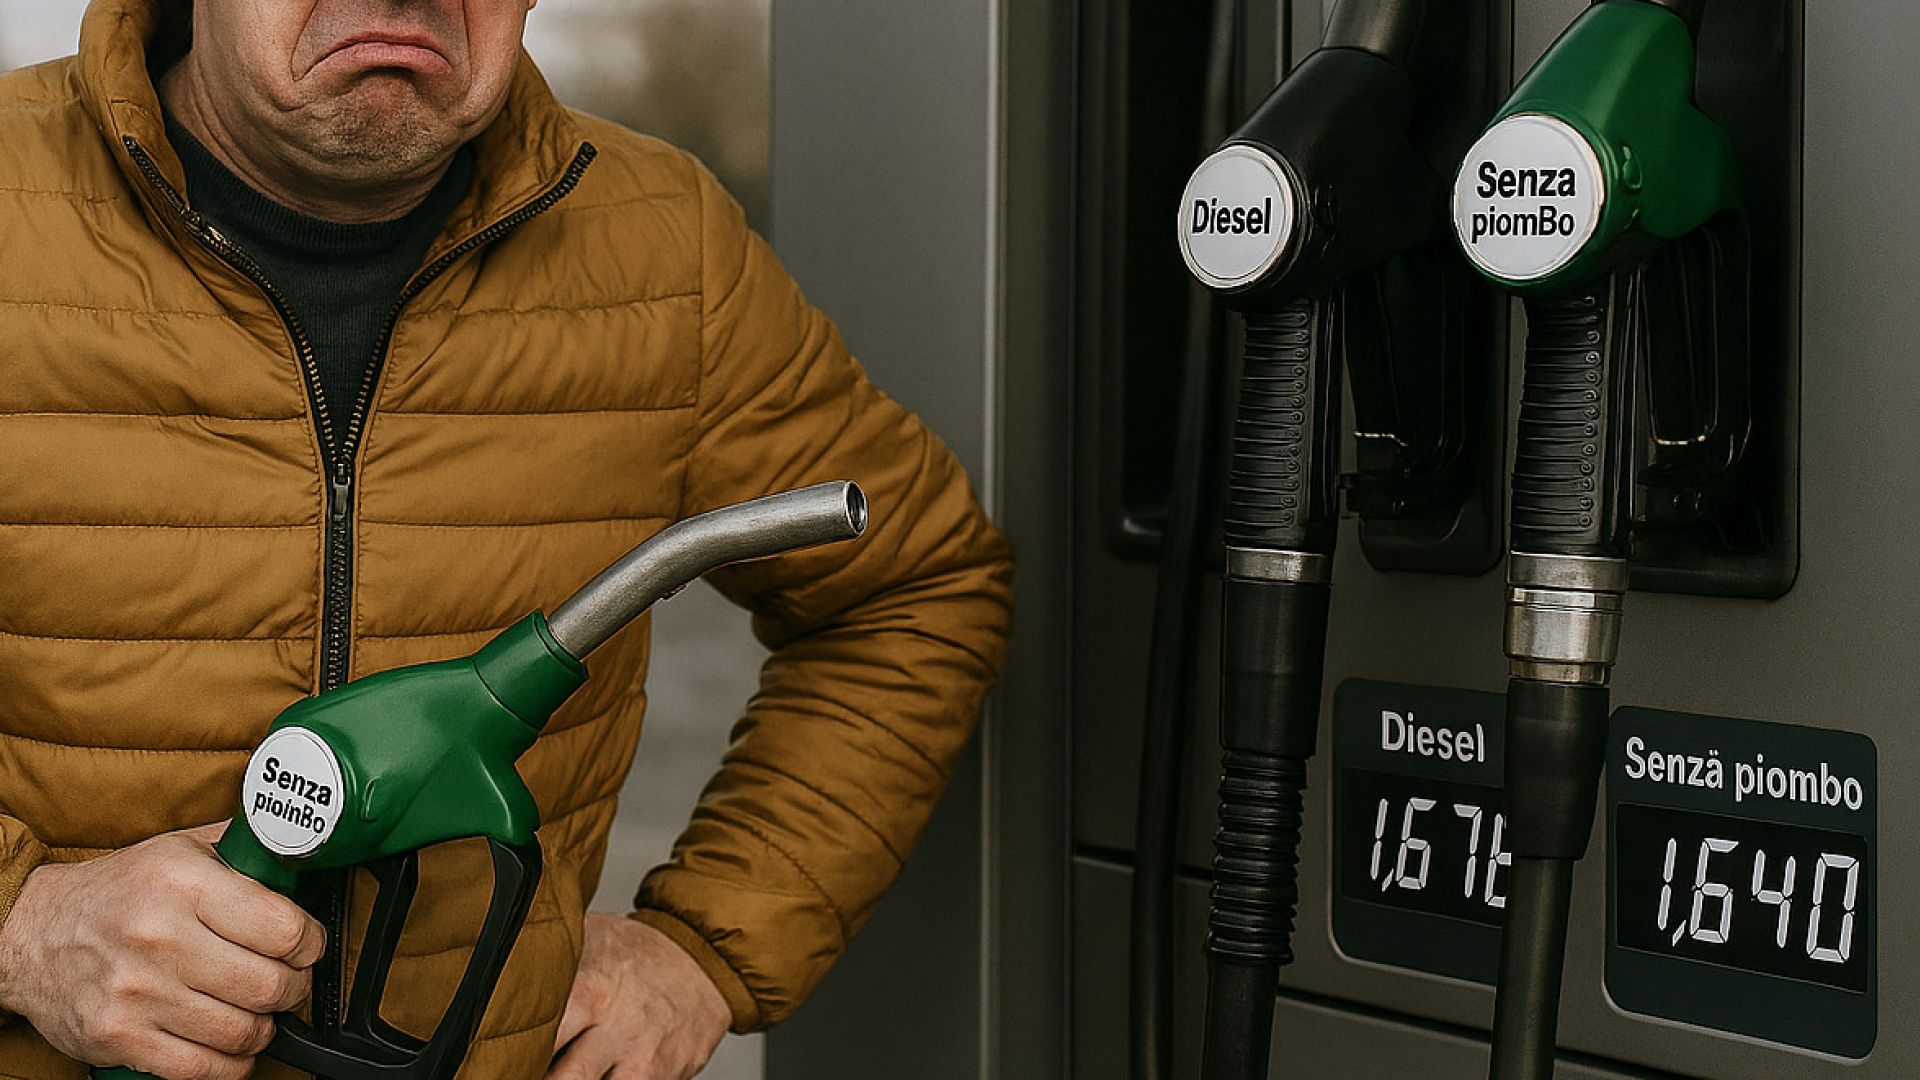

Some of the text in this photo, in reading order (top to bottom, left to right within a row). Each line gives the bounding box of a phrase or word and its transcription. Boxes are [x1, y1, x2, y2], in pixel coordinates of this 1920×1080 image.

[1476, 162, 1576, 197] Senza
[1191, 198, 1272, 234] Diesel
[1471, 205, 1575, 244] piomBo
[1381, 710, 1486, 763] Diesel
[262, 757, 332, 806] Senza
[1735, 753, 1863, 811] piombo
[1657, 837, 1860, 963] 1,640
